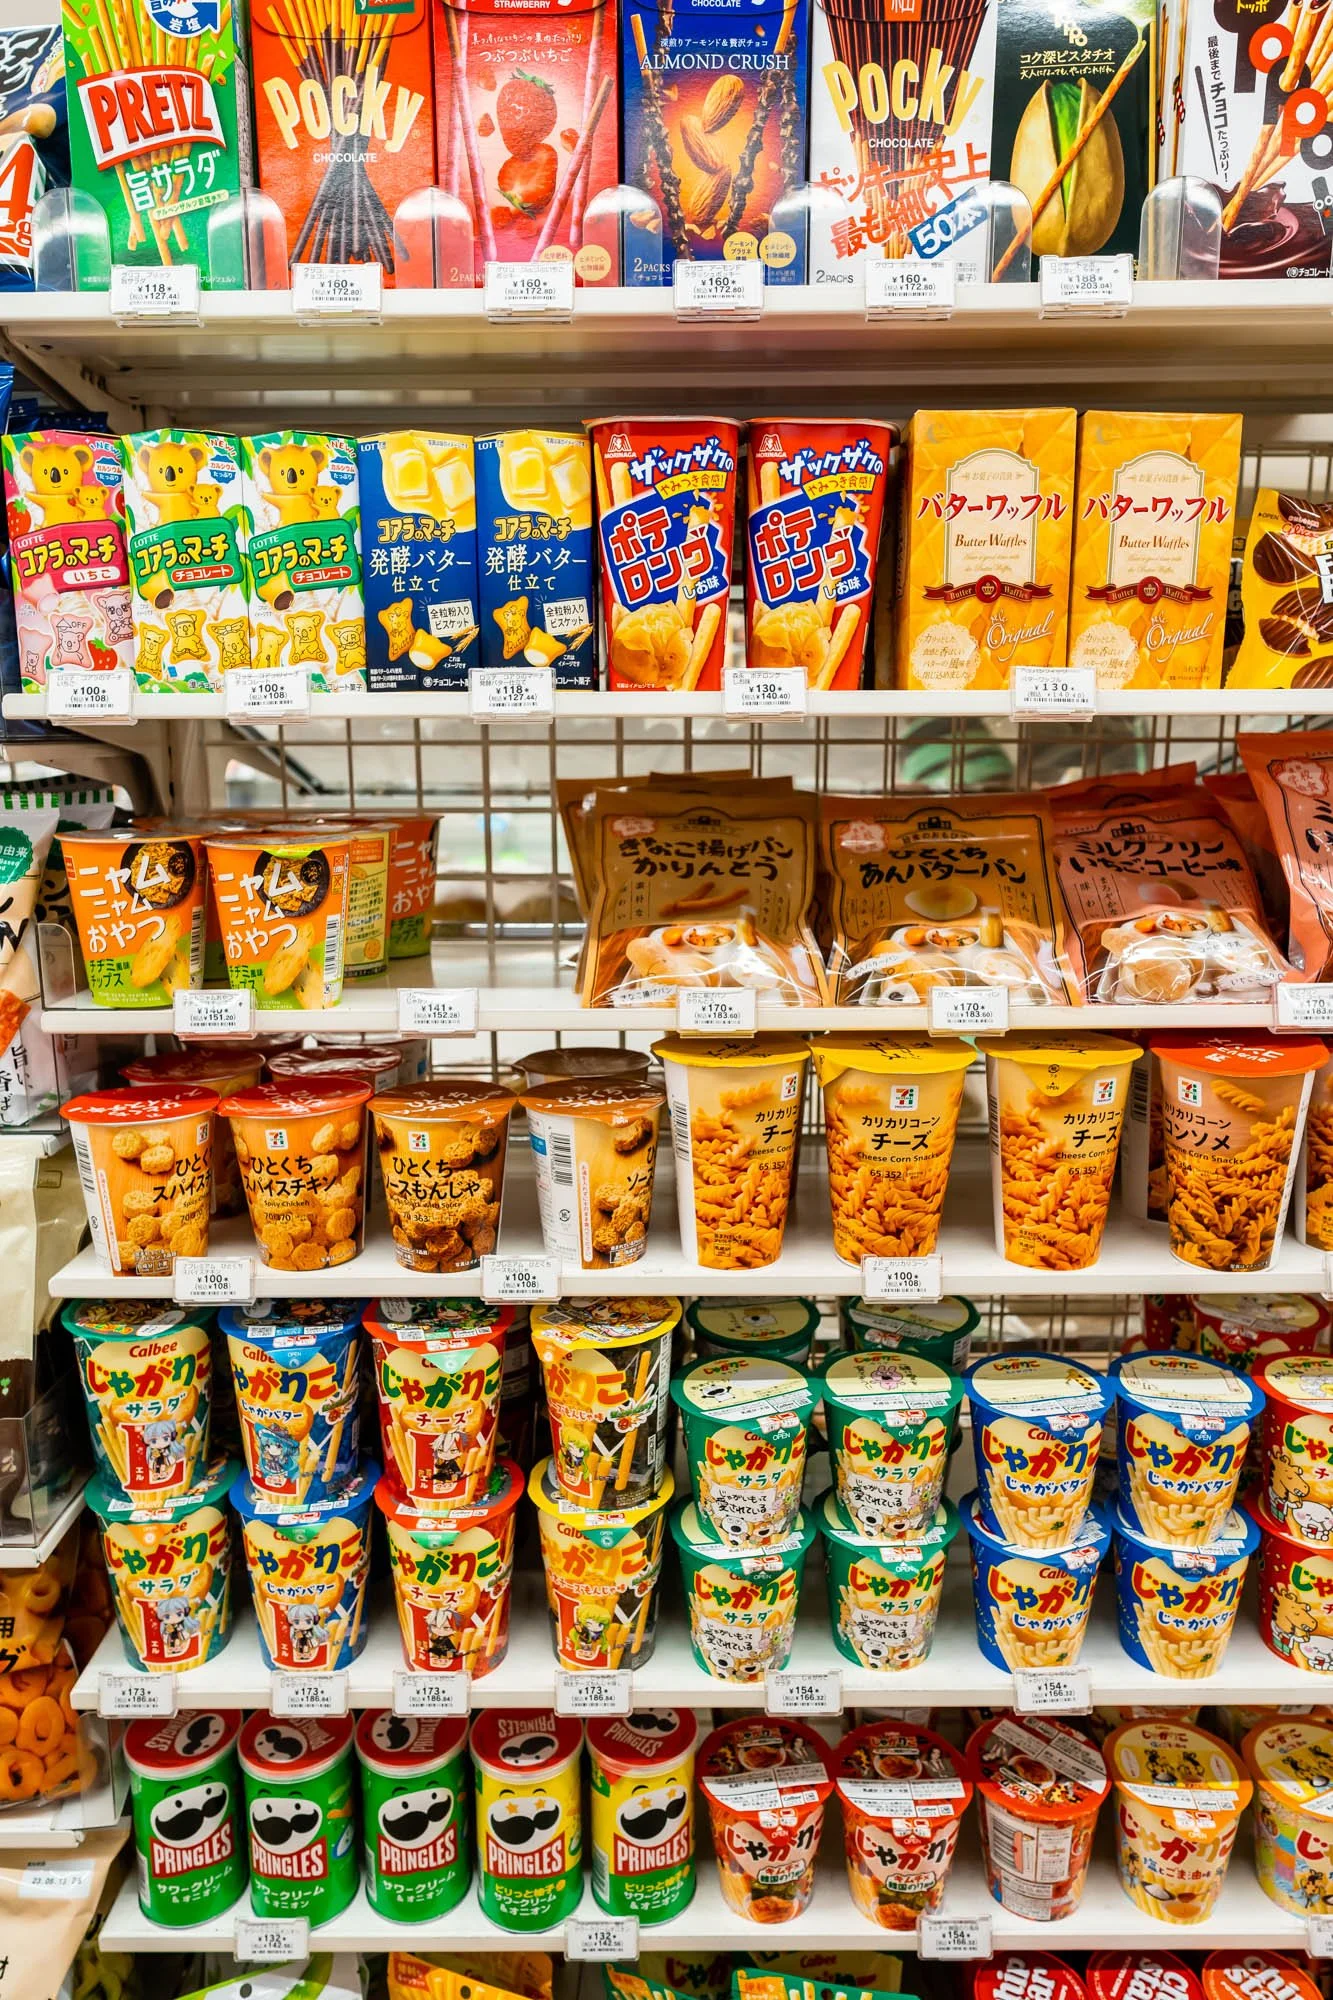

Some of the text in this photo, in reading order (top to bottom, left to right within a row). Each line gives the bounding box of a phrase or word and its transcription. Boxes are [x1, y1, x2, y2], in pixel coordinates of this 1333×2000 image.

[494, 0, 551, 9] STRAWBERRY
[691, 0, 741, 9] CHOCOLATE
[169, 18, 202, 33] 岩塩
[479, 47, 573, 63] つぶつぶいちご
[639, 53, 790, 71] ALMOND CRUSH
[1020, 48, 1116, 65] コク深ピスタチオ
[822, 47, 986, 137] POCKY
[88, 75, 213, 153] PRETZ
[262, 64, 425, 153] POCKY
[868, 138, 935, 149] CHOCOLATE
[312, 153, 378, 164] CHOCOLATE
[125, 148, 222, 212] 旨サラダ
[633, 257, 671, 273] 2PACKS
[630, 436, 734, 486] ザックザクの
[779, 438, 884, 486] ザックザクの
[917, 492, 1067, 521] バターワッフル
[1083, 494, 1231, 525] バターワッフル
[378, 516, 456, 543] コアラのマーチ
[494, 516, 572, 542] コアラのマーチ
[611, 506, 672, 564] ポテ
[755, 507, 815, 560] ポテ
[17, 534, 46, 549] LOTTE
[133, 532, 160, 549] LOTTE
[252, 534, 280, 549] LOTTE
[955, 533, 1028, 548] Butter Waffles
[1119, 535, 1190, 550] Butter Waffles
[18, 535, 117, 577] コアラのマーチ
[135, 533, 229, 575] コアラのマーチ
[255, 535, 348, 577] コアラのマーチ
[369, 544, 472, 578] 発酵バター
[485, 543, 587, 577] 発酵バター
[619, 526, 713, 602] ロング
[763, 525, 856, 601] ロング
[73, 569, 112, 581] いちご
[175, 565, 231, 582] チョコレート
[294, 567, 350, 583] チョコレート
[392, 575, 440, 593] 仕立て
[508, 575, 557, 592] 仕立て
[683, 576, 720, 600] しお味
[824, 578, 862, 599] しお味
[950, 584, 1030, 600] Butter Waffles
[1111, 587, 1190, 601] Butter Waffles
[430, 604, 470, 620] 全粒粉入り
[545, 603, 586, 620] 全粒粉入り
[434, 617, 470, 631] ビスケット
[549, 616, 584, 629] ビスケット
[986, 620, 1054, 662] Original
[1146, 620, 1214, 663] Original
[618, 835, 794, 860] きなこ揚げパン
[79, 855, 172, 897] ニャム
[632, 856, 779, 881] かりんとう
[859, 858, 1027, 889] あんバターパン
[218, 862, 304, 903] ニャム
[93, 892, 153, 920] ニャム
[230, 900, 286, 926] ニャム
[87, 915, 167, 953] おやつ
[226, 923, 299, 959] おやつ
[89, 958, 131, 973] チチミ風味
[91, 974, 125, 988] チップス
[861, 1115, 942, 1130] カリカリコーン
[1164, 1102, 1232, 1130] カリカリコーン
[871, 1129, 933, 1152] チーズ
[1072, 1126, 1119, 1149] チーズ
[1165, 1117, 1231, 1151] コンソメ
[250, 1155, 313, 1175] ひとくち
[856, 1151, 942, 1163] Cheese Corn Snacks
[1055, 1150, 1087, 1161] Cheese
[392, 1156, 454, 1178] ひとくち
[243, 1175, 338, 1197] スパイスチキン
[385, 1180, 481, 1201] ソースもんじゃ
[129, 1340, 178, 1358] Calbee
[125, 1393, 187, 1418] サラダ
[241, 1400, 303, 1421] じゃがバター
[415, 1409, 472, 1428] チーズ
[772, 1432, 791, 1441] OPEN
[898, 1428, 914, 1437] OPEN
[1194, 1433, 1212, 1442] OPEN
[135, 1466, 145, 1481] エル
[738, 1467, 786, 1487] サラダ
[873, 1465, 923, 1480] サラダ
[1146, 1470, 1233, 1494] じゃがバター
[855, 1479, 904, 1497] じゃがいもって
[1004, 1474, 1089, 1495] じゃがバター
[717, 1497, 768, 1514] 愛されている
[718, 1489, 768, 1503] じゃがいもって
[853, 1490, 903, 1508] 愛されている
[138, 1571, 200, 1595] サラダ
[265, 1582, 336, 1598] じゃがバター
[694, 1568, 797, 1609] じゃがりこ
[410, 1585, 465, 1604] チーズ
[881, 1595, 928, 1614] サラダ
[724, 1609, 772, 1625] サラダ
[860, 1613, 909, 1629] じゃがいもって
[1013, 1612, 1089, 1631] じゃがバター
[1156, 1610, 1235, 1631] じゃがバター
[706, 1623, 753, 1640] じゃがいもって
[856, 1621, 908, 1640] 愛されている
[705, 1631, 753, 1652] 愛されている
[498, 1713, 555, 1737] PRINGLES
[604, 1721, 664, 1758] PRINGLES
[152, 1822, 233, 1875] PRINGLES
[251, 1837, 323, 1879] PRINGLES
[380, 1830, 455, 1876] PRINGLES
[488, 1841, 563, 1876] PRINGLES
[617, 1830, 689, 1873] PRINGLES
[1143, 1856, 1212, 1881] 塩とごま油味
[157, 1866, 233, 1894] サワークリーム
[255, 1880, 326, 1900] サワークリーム
[383, 1870, 456, 1895] サワークリーム
[494, 1891, 557, 1907] サワークリーム
[624, 1880, 685, 1902] サワークリーム
